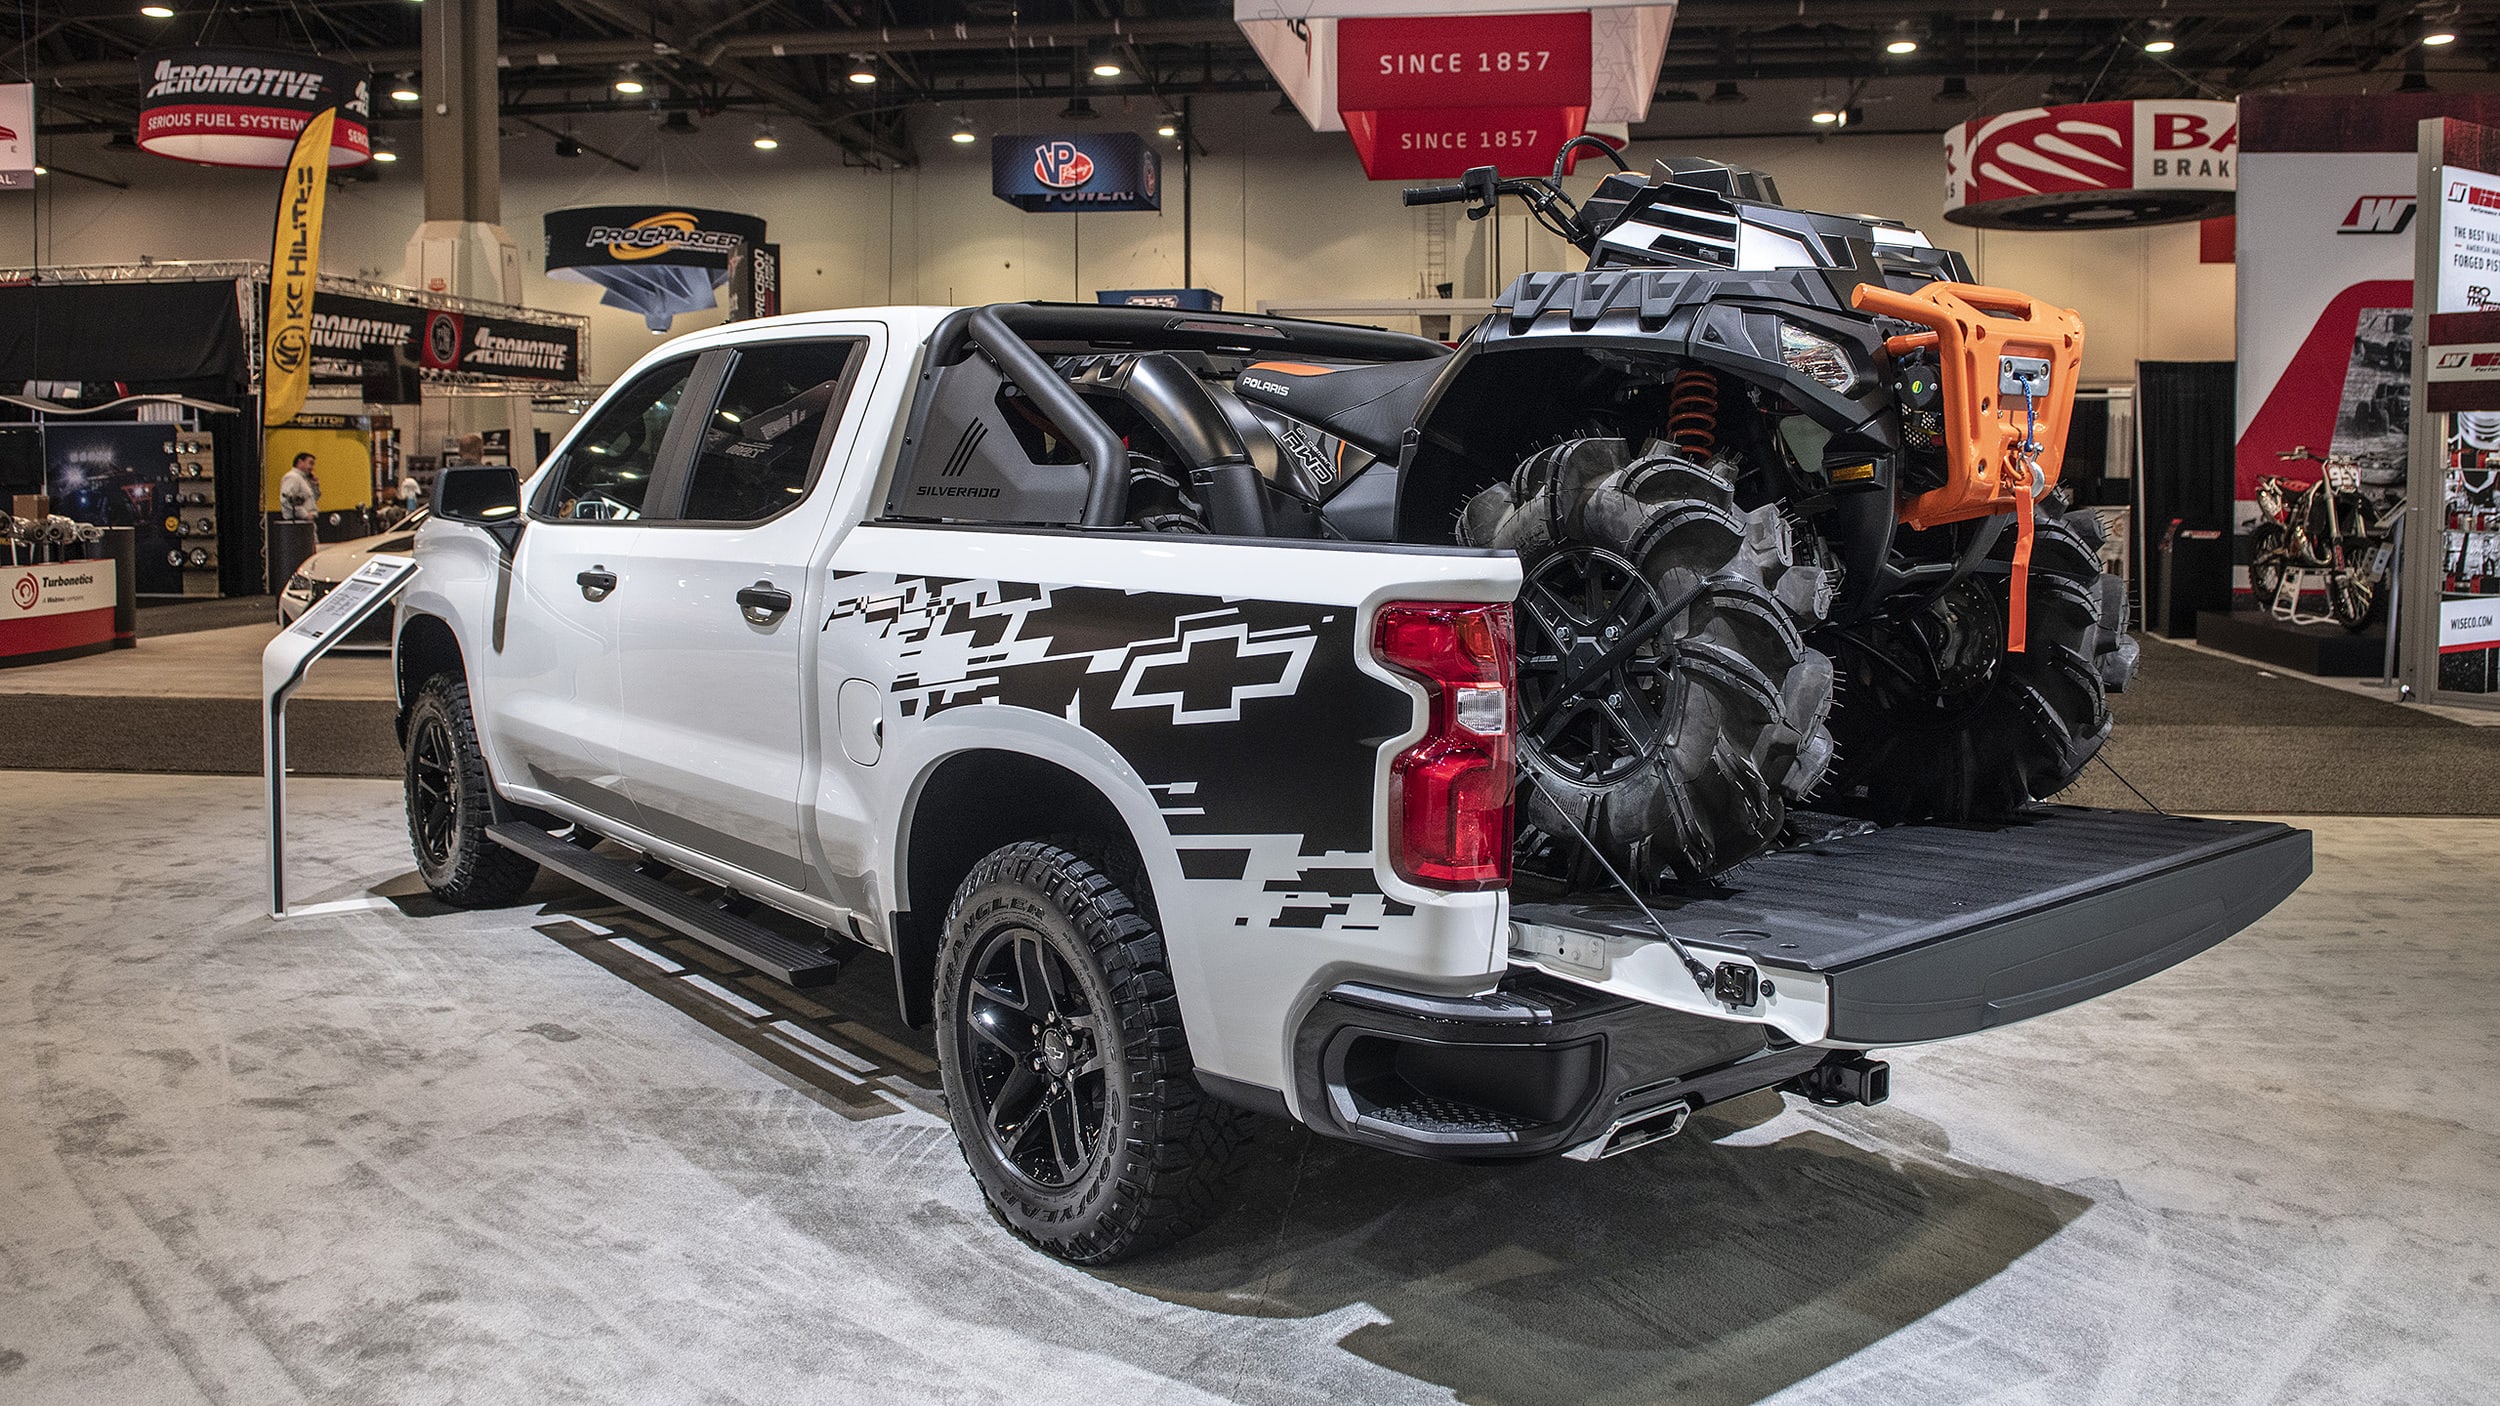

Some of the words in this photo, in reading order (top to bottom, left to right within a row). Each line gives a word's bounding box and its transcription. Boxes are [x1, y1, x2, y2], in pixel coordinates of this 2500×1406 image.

[1380, 53, 1462, 75] SINCE
[1478, 51, 1551, 73] 1857
[146, 58, 323, 101] AEROMOTIVE
[148, 113, 191, 131] SERIOUS
[195, 113, 235, 127] FUEL
[239, 114, 307, 132] SYSTEM
[1401, 132, 1468, 149] SINCE
[1480, 130, 1539, 148] 1857
[1035, 141, 1077, 185] VP
[2154, 158, 2230, 178] BRAK
[2454, 226, 2467, 239] THE
[2469, 227, 2485, 242] BEST
[2454, 253, 2485, 271] FORGED
[286, 281, 304, 320] KC
[309, 312, 412, 351] ROMOTIVE
[464, 326, 568, 371] AEROMOTIVE
[1242, 376, 1290, 397] POLARIS
[1281, 430, 1334, 485] AWD
[916, 486, 1001, 498] SILVERADO
[42, 573, 94, 588] Turbonetics
[2450, 615, 2493, 631] WISECO.COM
[1000, 1088, 1121, 1224] GOODYEAR
